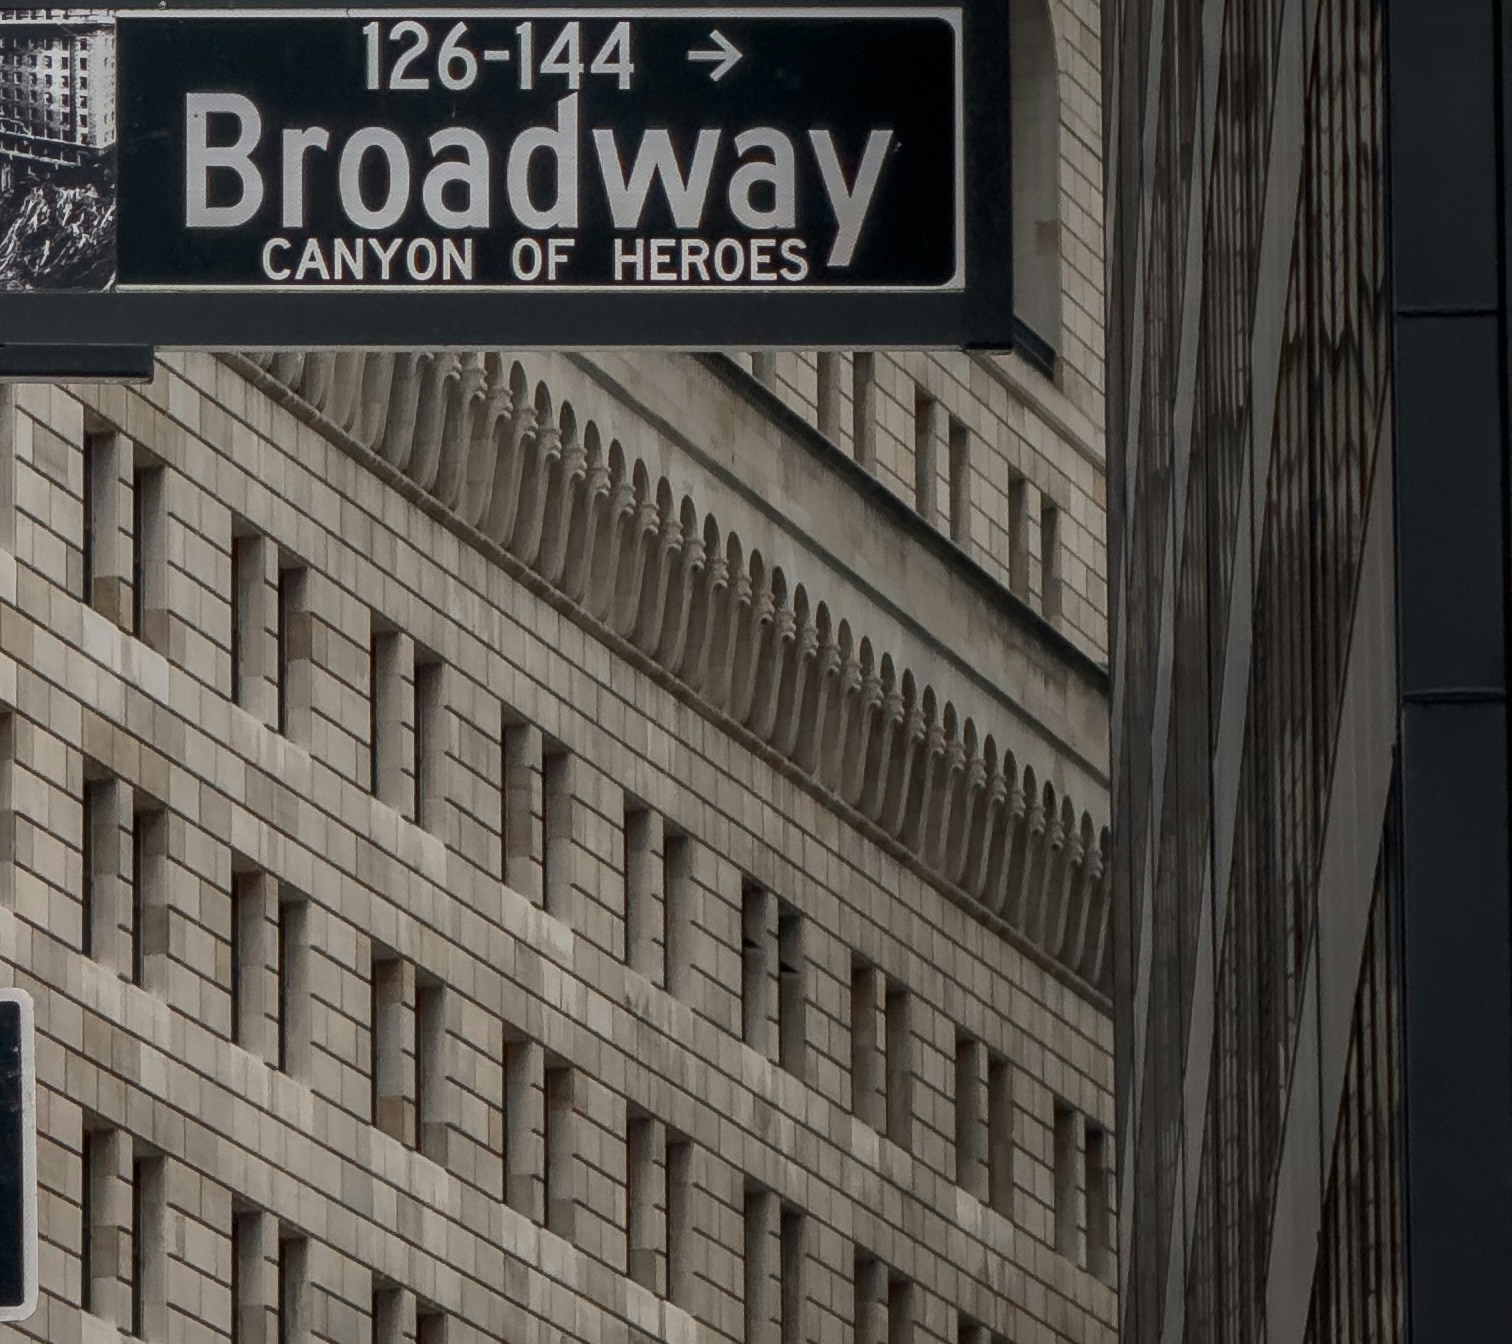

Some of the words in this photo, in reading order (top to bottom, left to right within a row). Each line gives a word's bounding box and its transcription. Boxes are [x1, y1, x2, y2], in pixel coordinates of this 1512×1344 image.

[363, 20, 635, 90] 126-144
[185, 91, 894, 267] Broadway
[263, 238, 472, 280] CANYON
[513, 238, 575, 280] OF
[615, 238, 808, 281] HEROES
